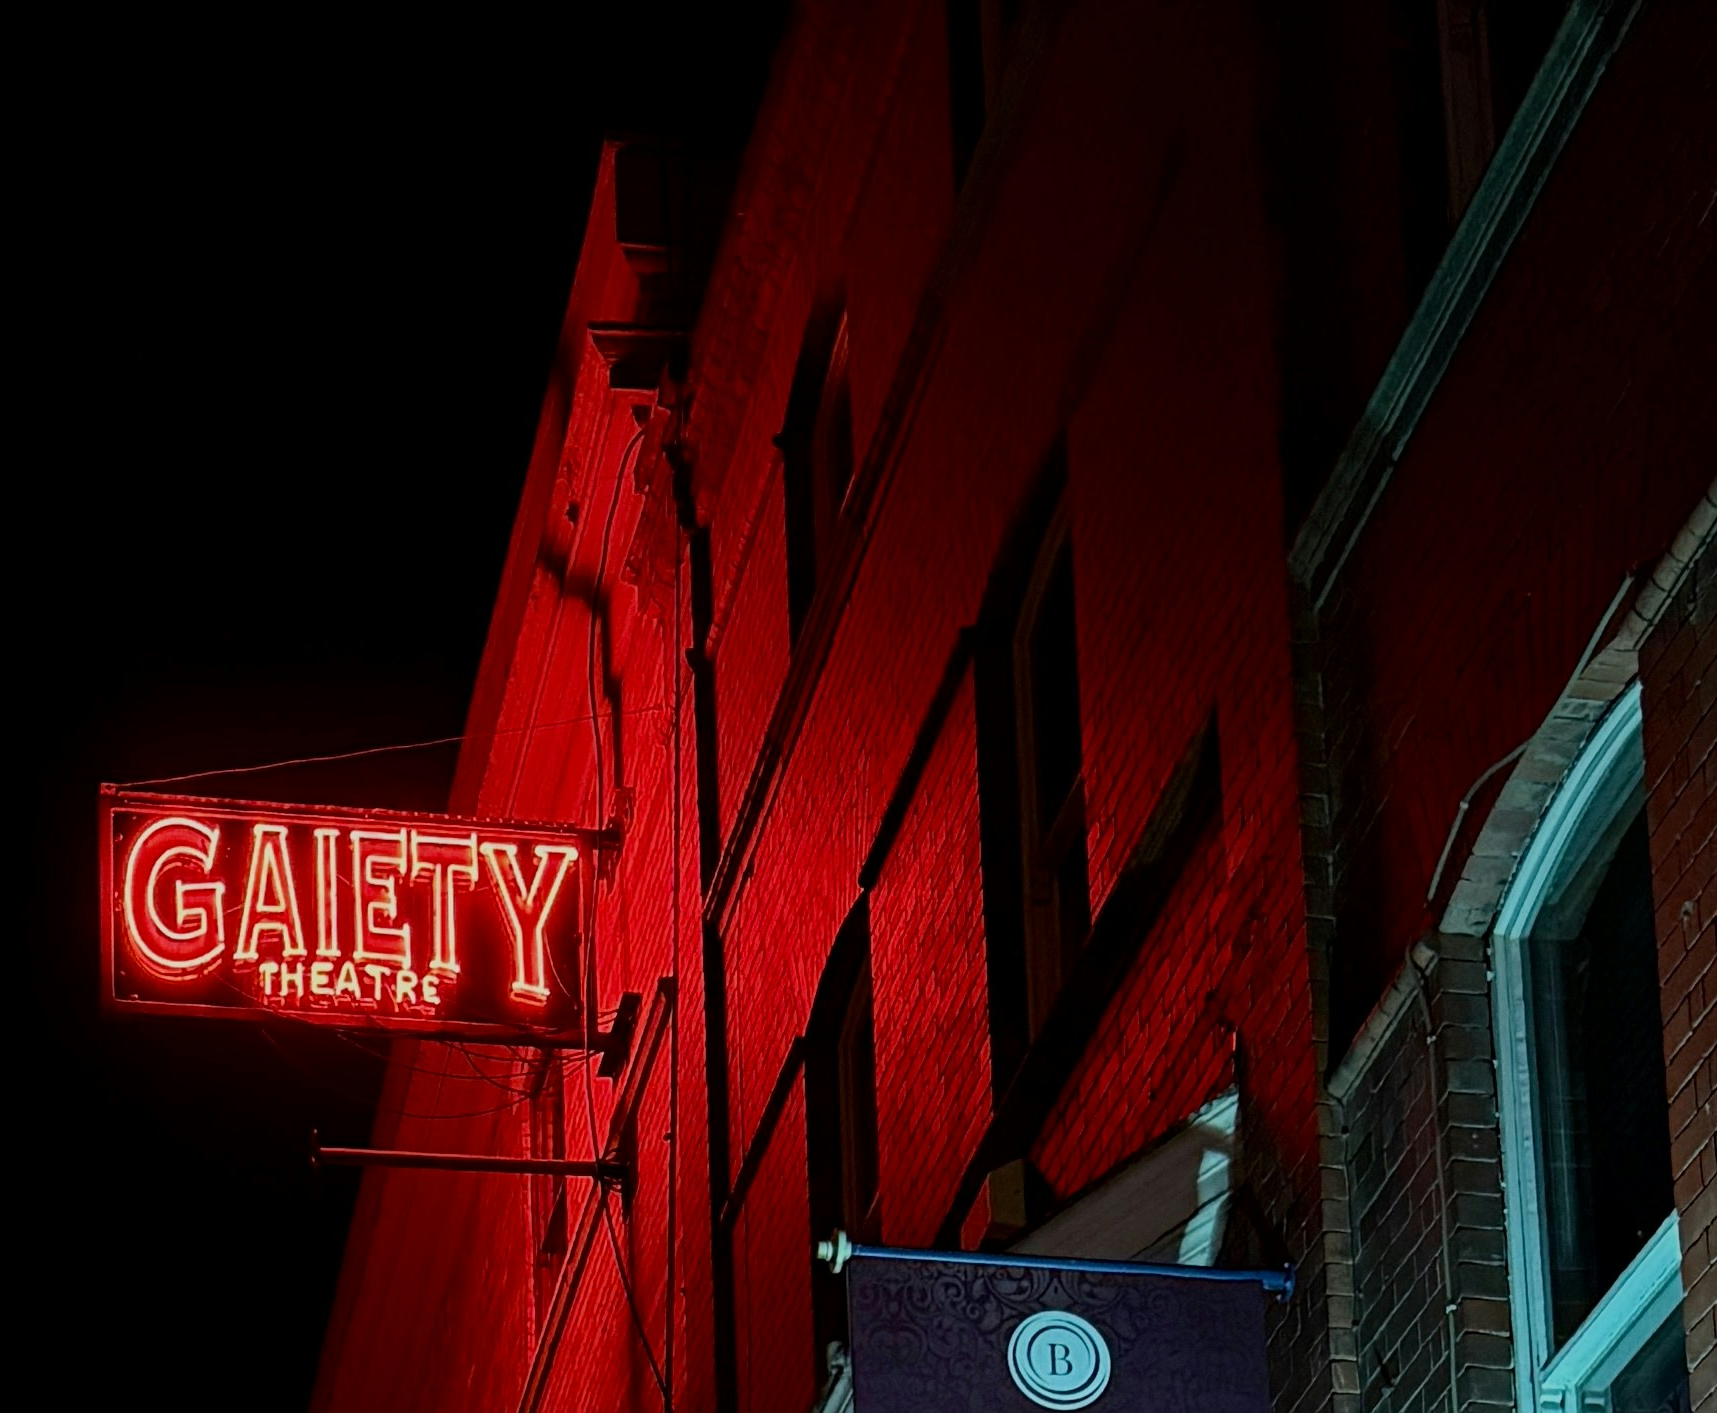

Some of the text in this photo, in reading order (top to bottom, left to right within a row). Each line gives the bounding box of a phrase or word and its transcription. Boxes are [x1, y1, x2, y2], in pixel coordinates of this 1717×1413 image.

[123, 816, 578, 1006] GAIETY
[259, 960, 442, 1006] THEATRE
[1047, 1342, 1074, 1377] B
